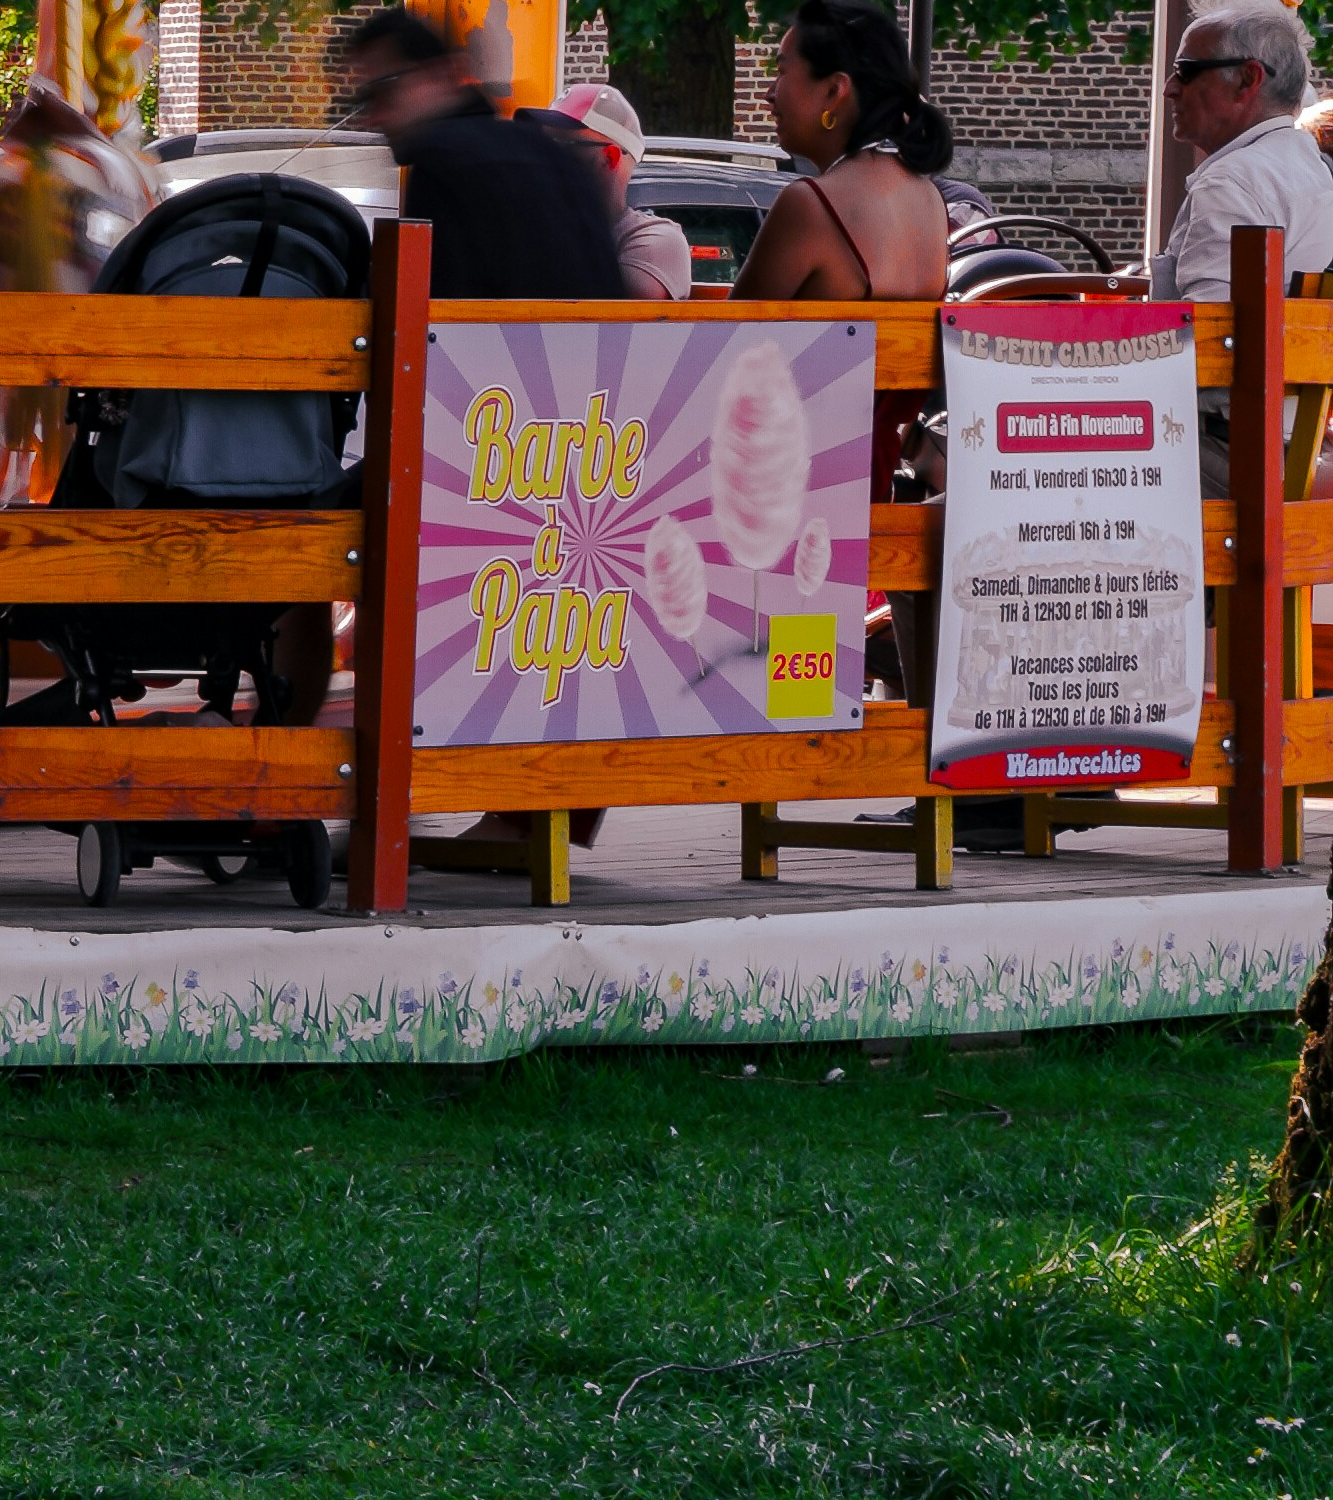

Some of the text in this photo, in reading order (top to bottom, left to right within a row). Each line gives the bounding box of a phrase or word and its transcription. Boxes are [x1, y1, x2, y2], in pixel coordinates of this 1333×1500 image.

[961, 328, 1184, 368] LE PETIT CARROUSEL
[1031, 376, 1064, 385] DIRECTION
[1006, 412, 1145, 437] D'Avril à Fin Novembre
[463, 384, 649, 505] Barbe
[990, 465, 1162, 492] Mardi, Vendredi 16h30 à 19H
[533, 502, 568, 580] à
[1018, 519, 1135, 542] Mercredi 16h à 19H
[971, 574, 1024, 598] Samedi,
[1028, 573, 1091, 596] Dimanche
[1094, 573, 1103, 594] &
[999, 597, 1149, 623] 11H à 12H30 et 16h à 19H
[469, 555, 632, 710] Papa
[772, 652, 833, 681] 2€50
[1011, 651, 1138, 676] Vacances scolaires
[1028, 678, 1120, 702] Tous les jours
[974, 702, 1167, 730] de 11H à 12H30 et de 16h à 19H
[1005, 748, 1142, 779] Wambrechies
